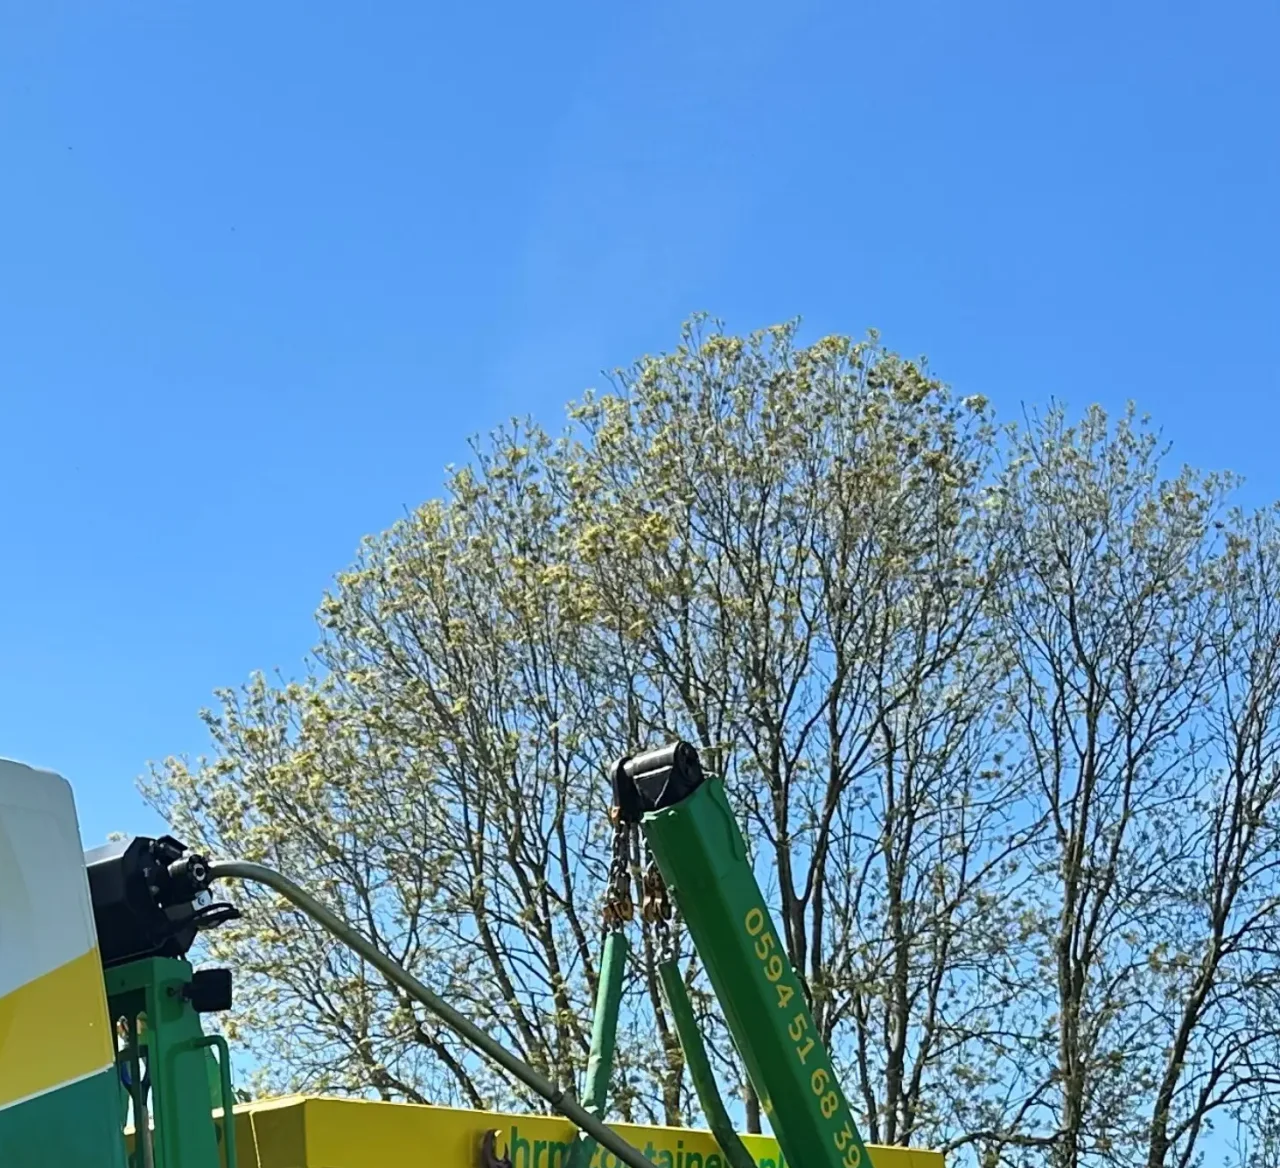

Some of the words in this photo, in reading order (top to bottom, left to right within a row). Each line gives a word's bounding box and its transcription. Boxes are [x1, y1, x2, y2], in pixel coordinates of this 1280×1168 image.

[745, 907, 795, 1008] 0594
[788, 1013, 815, 1065] 51
[811, 1068, 839, 1119] 68
